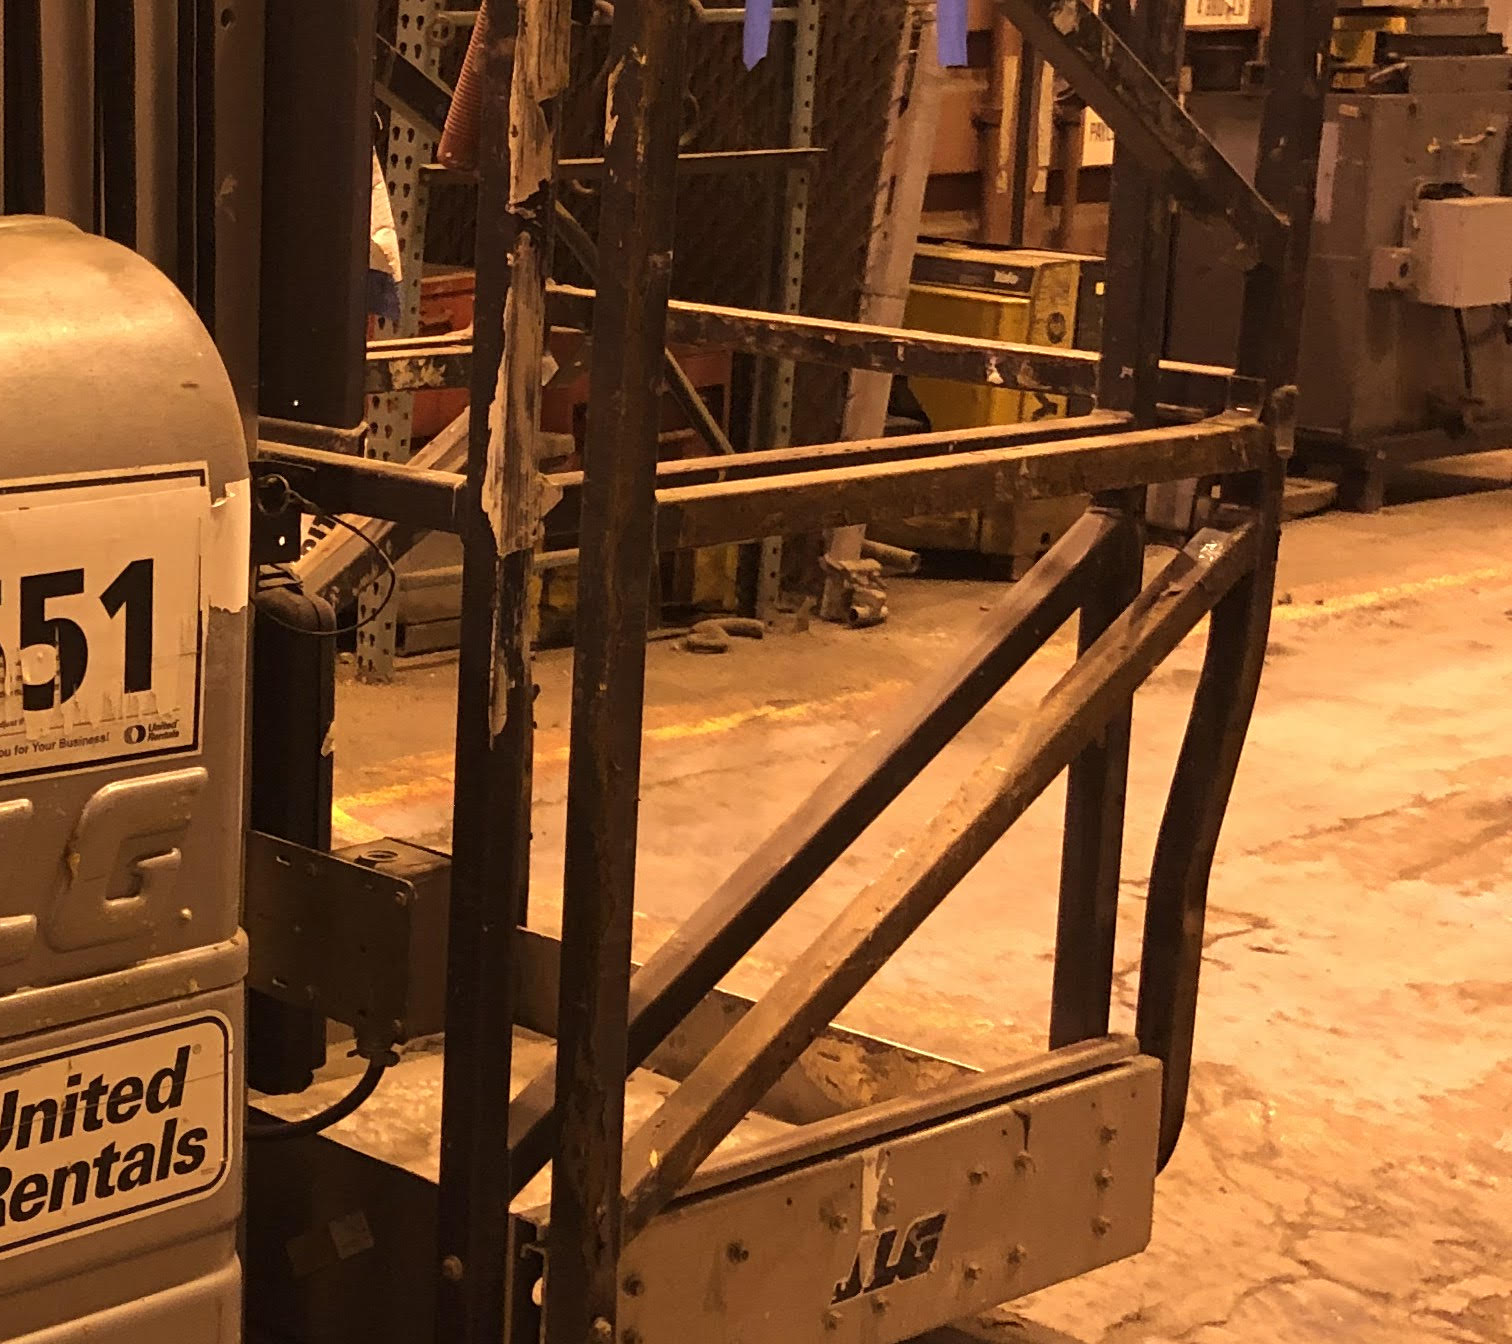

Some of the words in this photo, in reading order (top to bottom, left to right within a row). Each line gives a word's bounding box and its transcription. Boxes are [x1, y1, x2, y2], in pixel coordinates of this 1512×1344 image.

[147, 728, 180, 742] Rentals
[148, 721, 176, 732] United
[14, 744, 29, 755] for
[32, 740, 57, 753] Your
[59, 731, 110, 749] Business!
[829, 1211, 949, 1305] JLG
